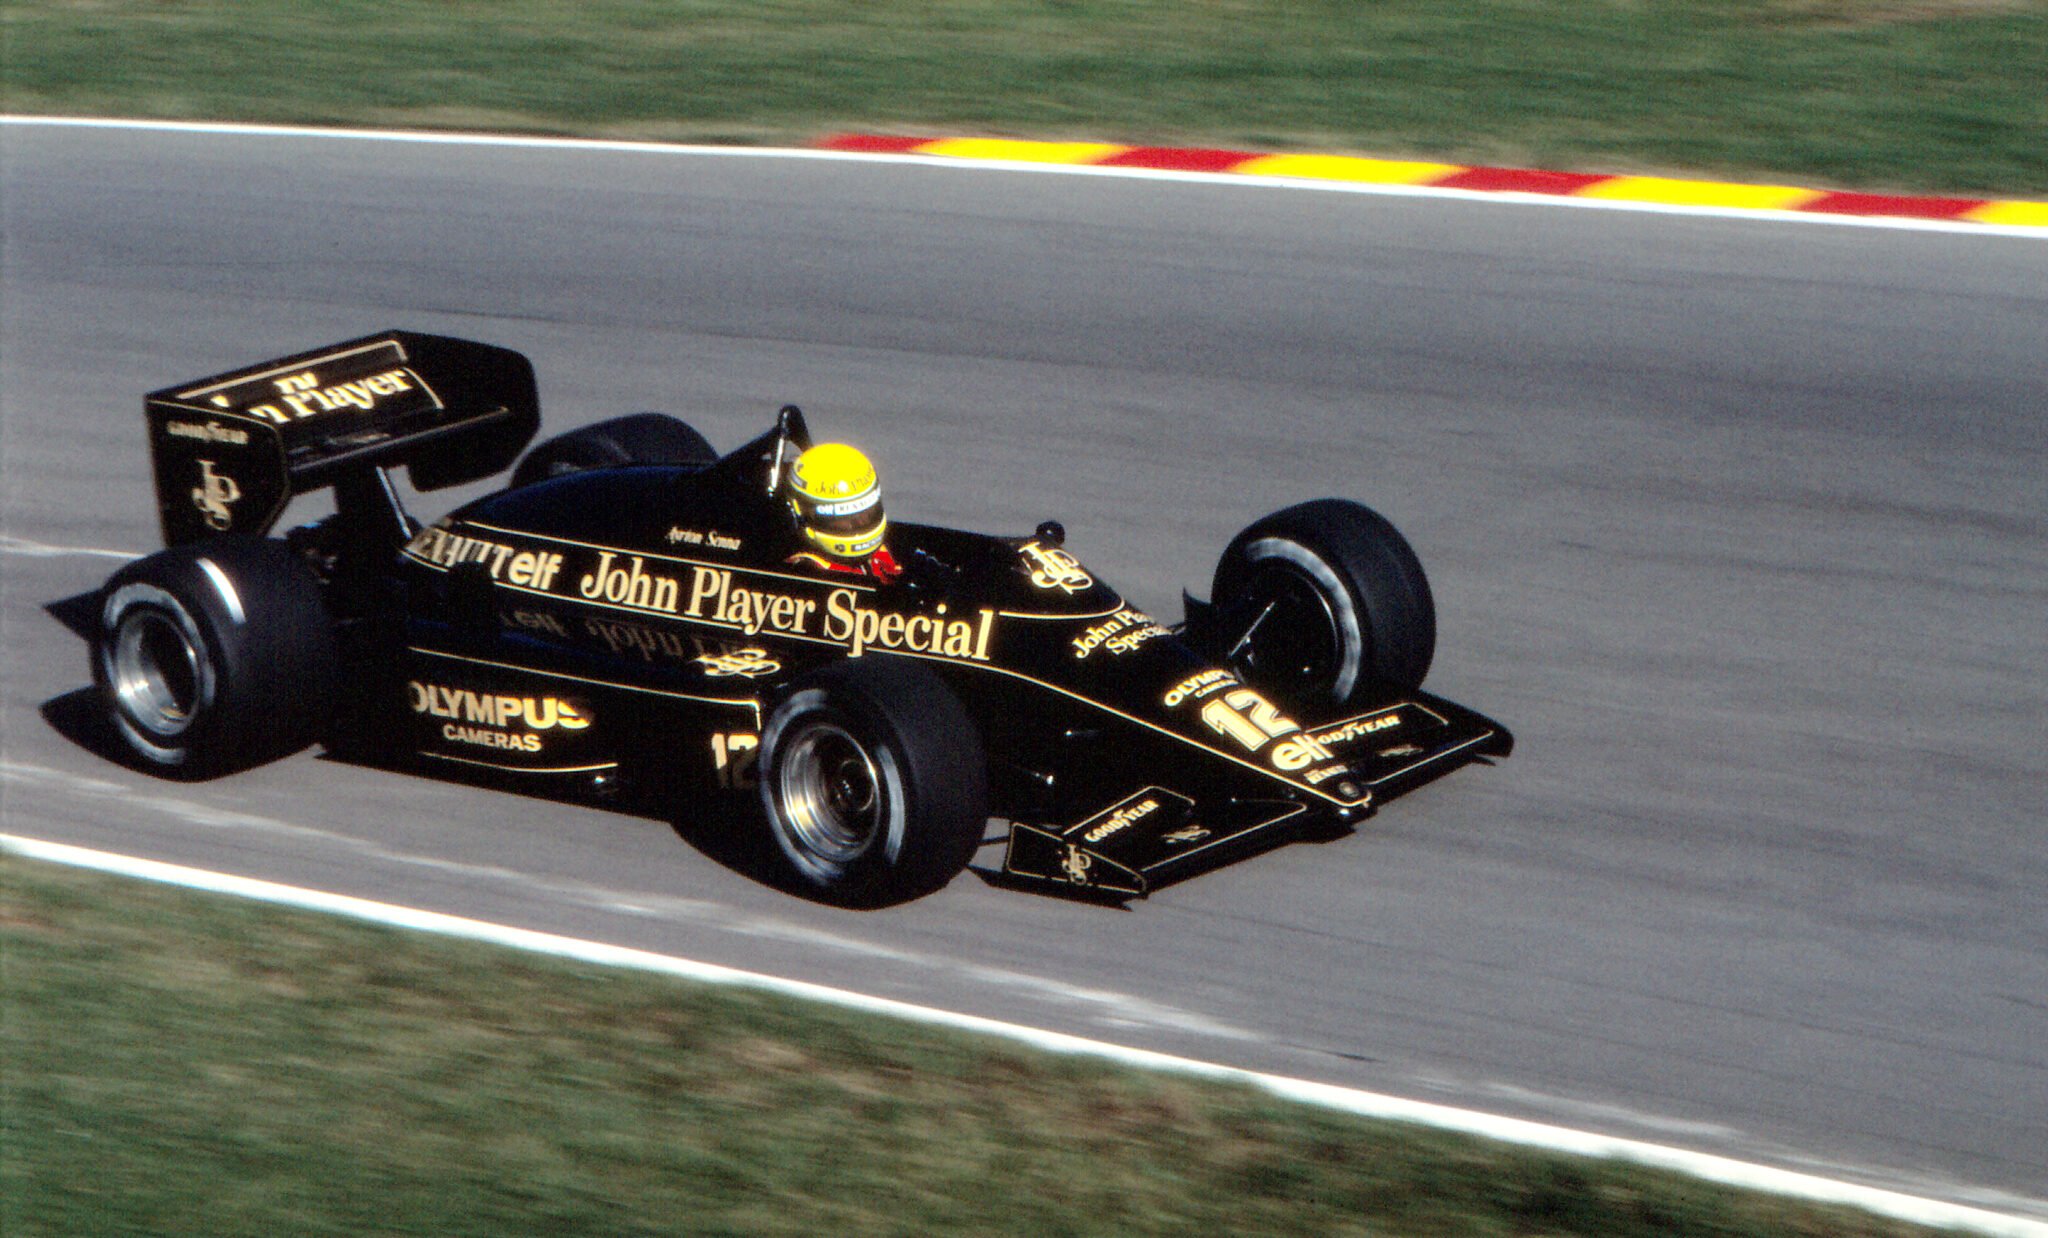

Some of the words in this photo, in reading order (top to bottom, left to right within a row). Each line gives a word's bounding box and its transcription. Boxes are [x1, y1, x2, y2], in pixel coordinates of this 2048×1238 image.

[508, 550, 563, 591] elf
[580, 551, 678, 614] John
[684, 566, 815, 636] Player
[824, 588, 995, 661] Special
[1071, 619, 1123, 659] John
[442, 723, 543, 753] CAMERAS
[1200, 688, 1304, 752] 12
[1084, 800, 1160, 843] GOODYEAR
